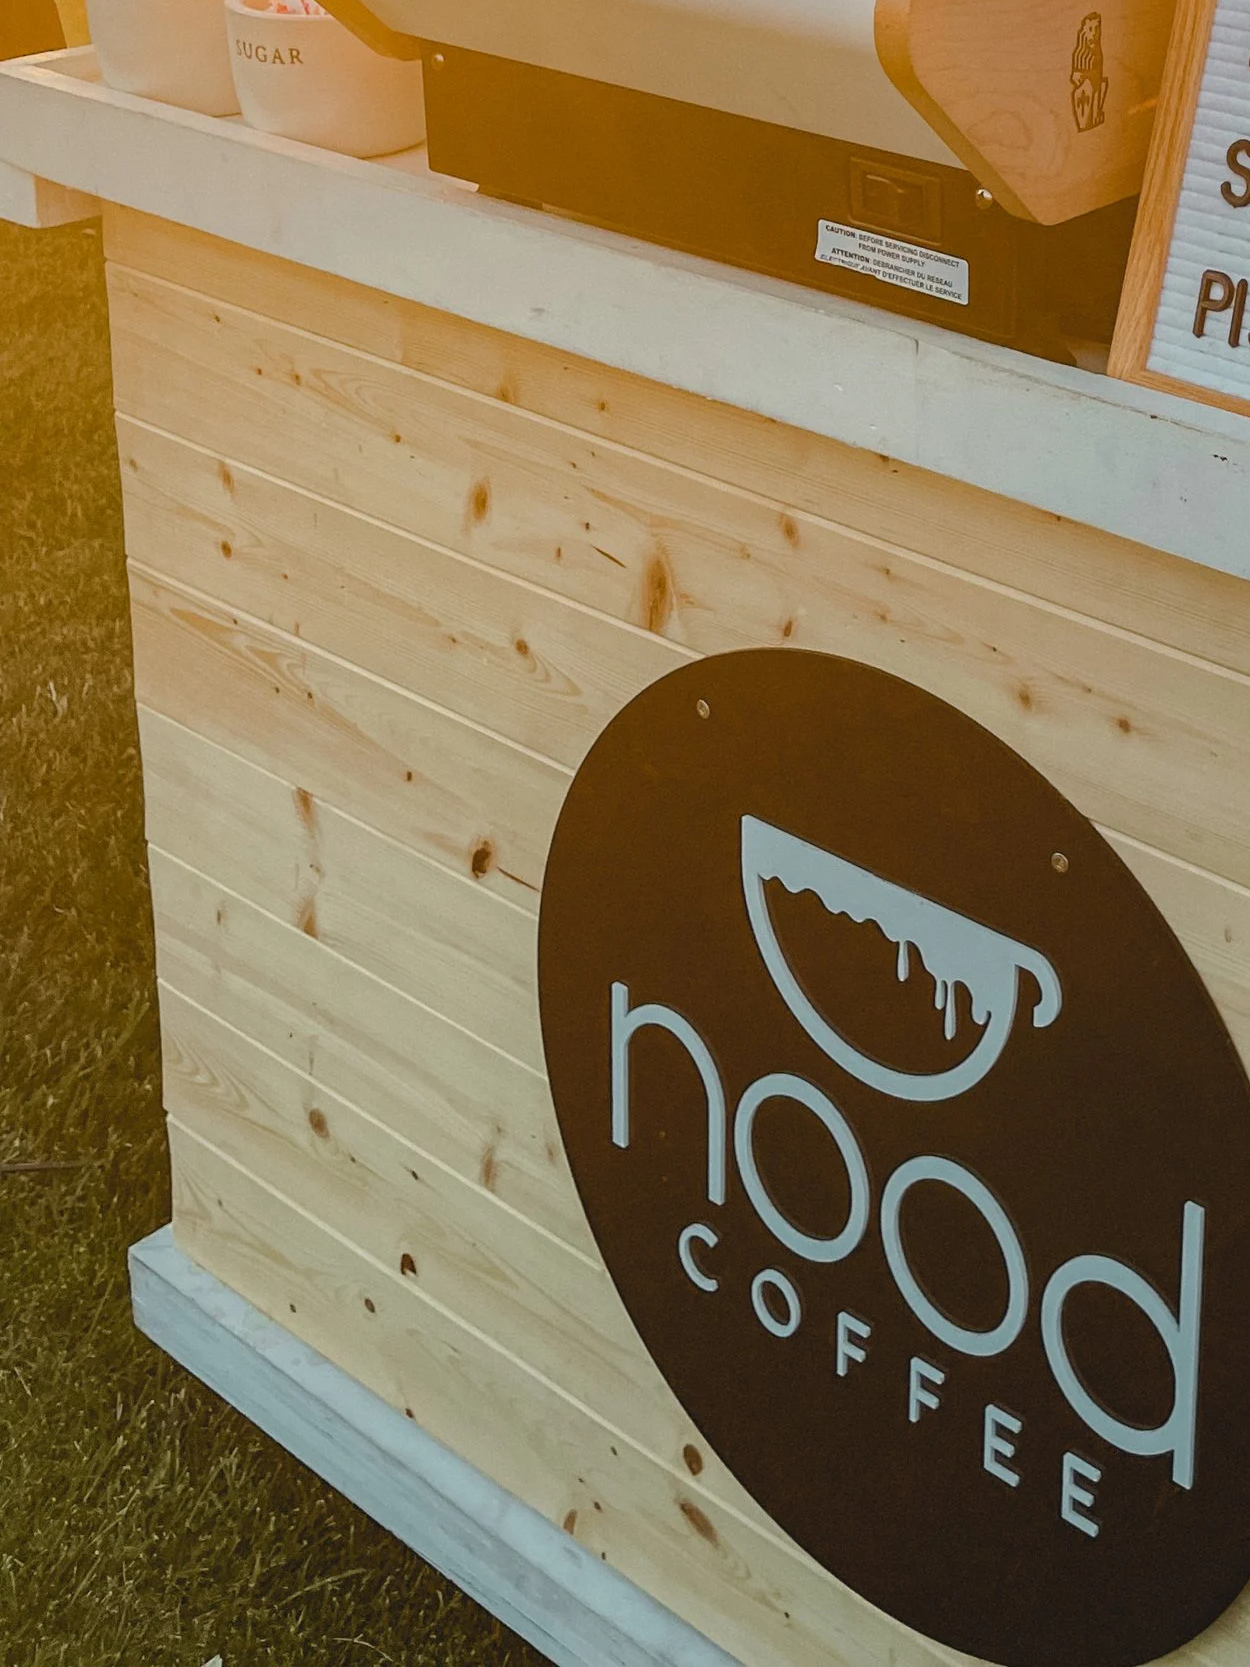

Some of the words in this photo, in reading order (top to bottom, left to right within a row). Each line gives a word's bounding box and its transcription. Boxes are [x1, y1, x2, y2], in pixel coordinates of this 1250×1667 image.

[235, 38, 304, 65] SUGAR
[858, 233, 883, 247] BEFORE
[884, 239, 918, 256] SERVICING
[918, 250, 960, 268] DISCONNECT
[858, 242, 877, 254] FROM
[877, 247, 901, 260] POWER
[901, 255, 926, 268] SUPPLY
[860, 265, 881, 276] AVANT
[925, 283, 934, 293] LE
[934, 286, 963, 301] SERVICE
[872, 258, 916, 276] DEBRANCHER
[916, 271, 926, 280] DU
[926, 274, 953, 288] RESEAU
[610, 980, 1206, 1491] nood
[677, 1221, 1102, 1538] COFFEE
